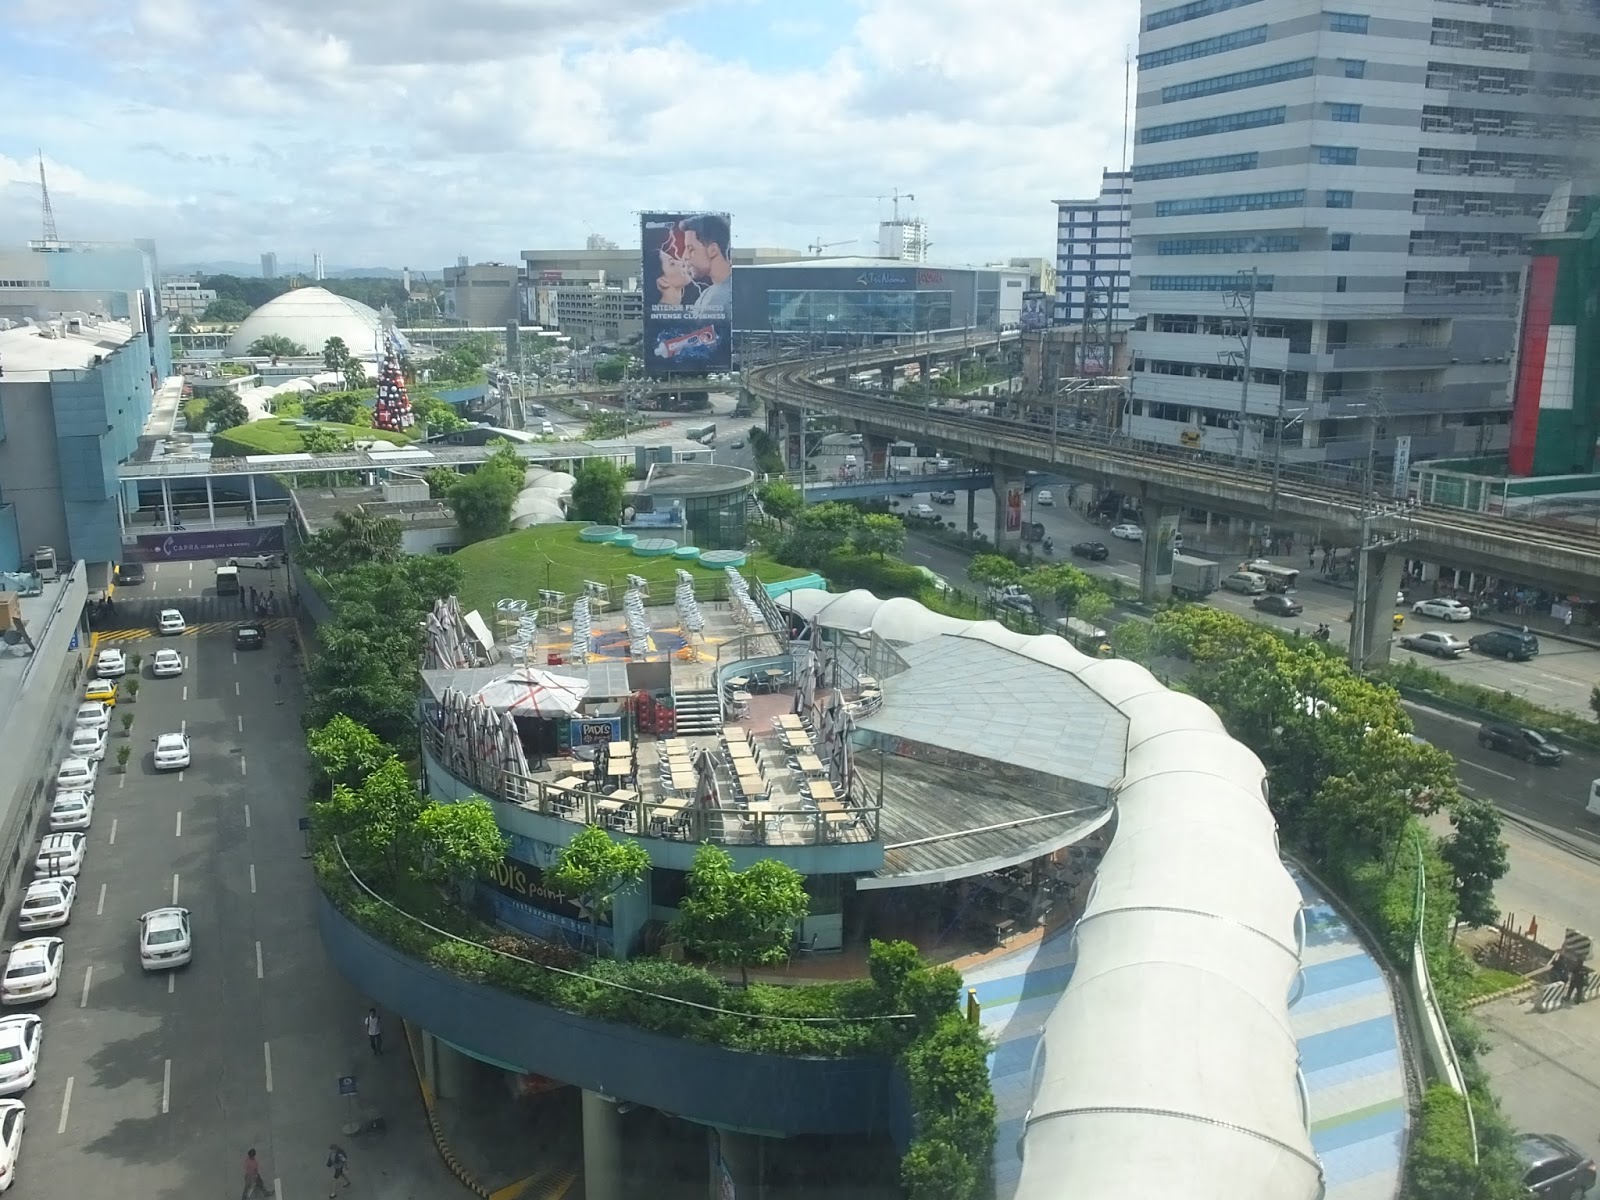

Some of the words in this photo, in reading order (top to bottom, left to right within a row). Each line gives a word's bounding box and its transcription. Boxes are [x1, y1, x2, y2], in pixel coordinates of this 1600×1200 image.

[583, 724, 610, 735] PADI'S
[529, 883, 566, 904] point
[512, 901, 556, 922] restaurant
[570, 920, 587, 931] bar
